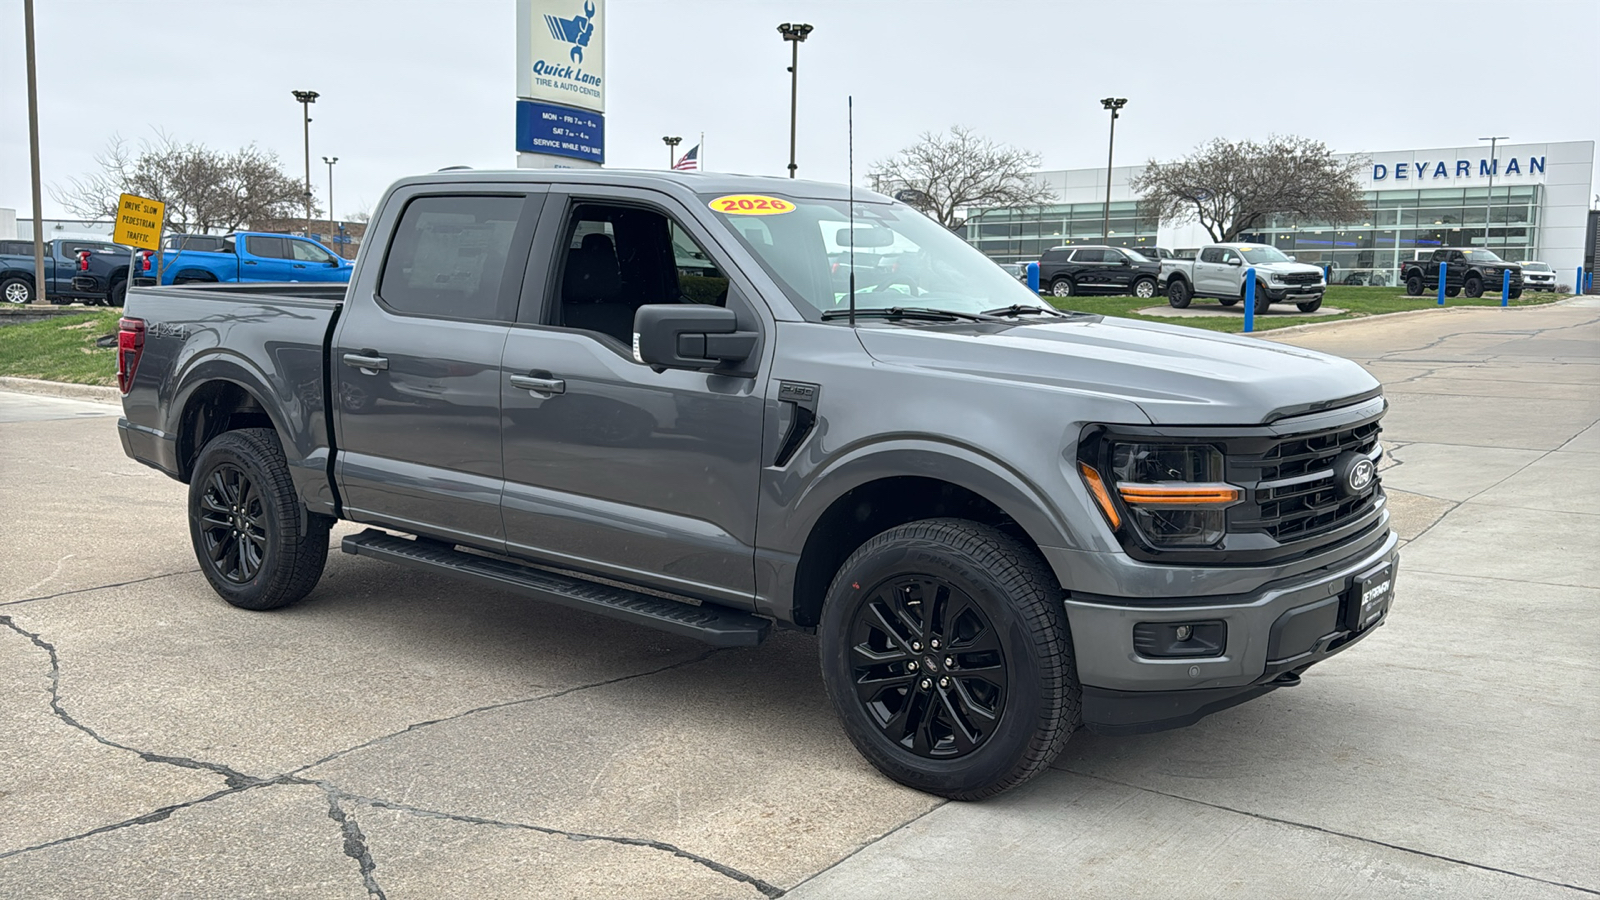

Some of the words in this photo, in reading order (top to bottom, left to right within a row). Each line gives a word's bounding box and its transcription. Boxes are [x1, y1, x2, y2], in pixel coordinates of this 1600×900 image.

[533, 60, 574, 79] Quick
[574, 68, 601, 87] Lane
[535, 77, 552, 87] TIRE
[553, 80, 559, 89] &
[560, 82, 578, 92] AUTO
[579, 86, 601, 98] CENTER
[542, 112, 557, 121] MON
[563, 115, 573, 124] FRI
[552, 127, 564, 135] SAT
[533, 138, 560, 148] SERVICE
[561, 142, 579, 151] WHILE
[580, 145, 591, 153] YOU
[591, 147, 602, 155] WAIT
[1373, 156, 1546, 181] DEYARMAN
[124, 201, 141, 212] DRIVE
[143, 205, 158, 215] SLOW
[721, 199, 787, 211] 2026
[122, 214, 156, 229] PEDESTRIAN
[127, 230, 149, 243] TRAFFIC
